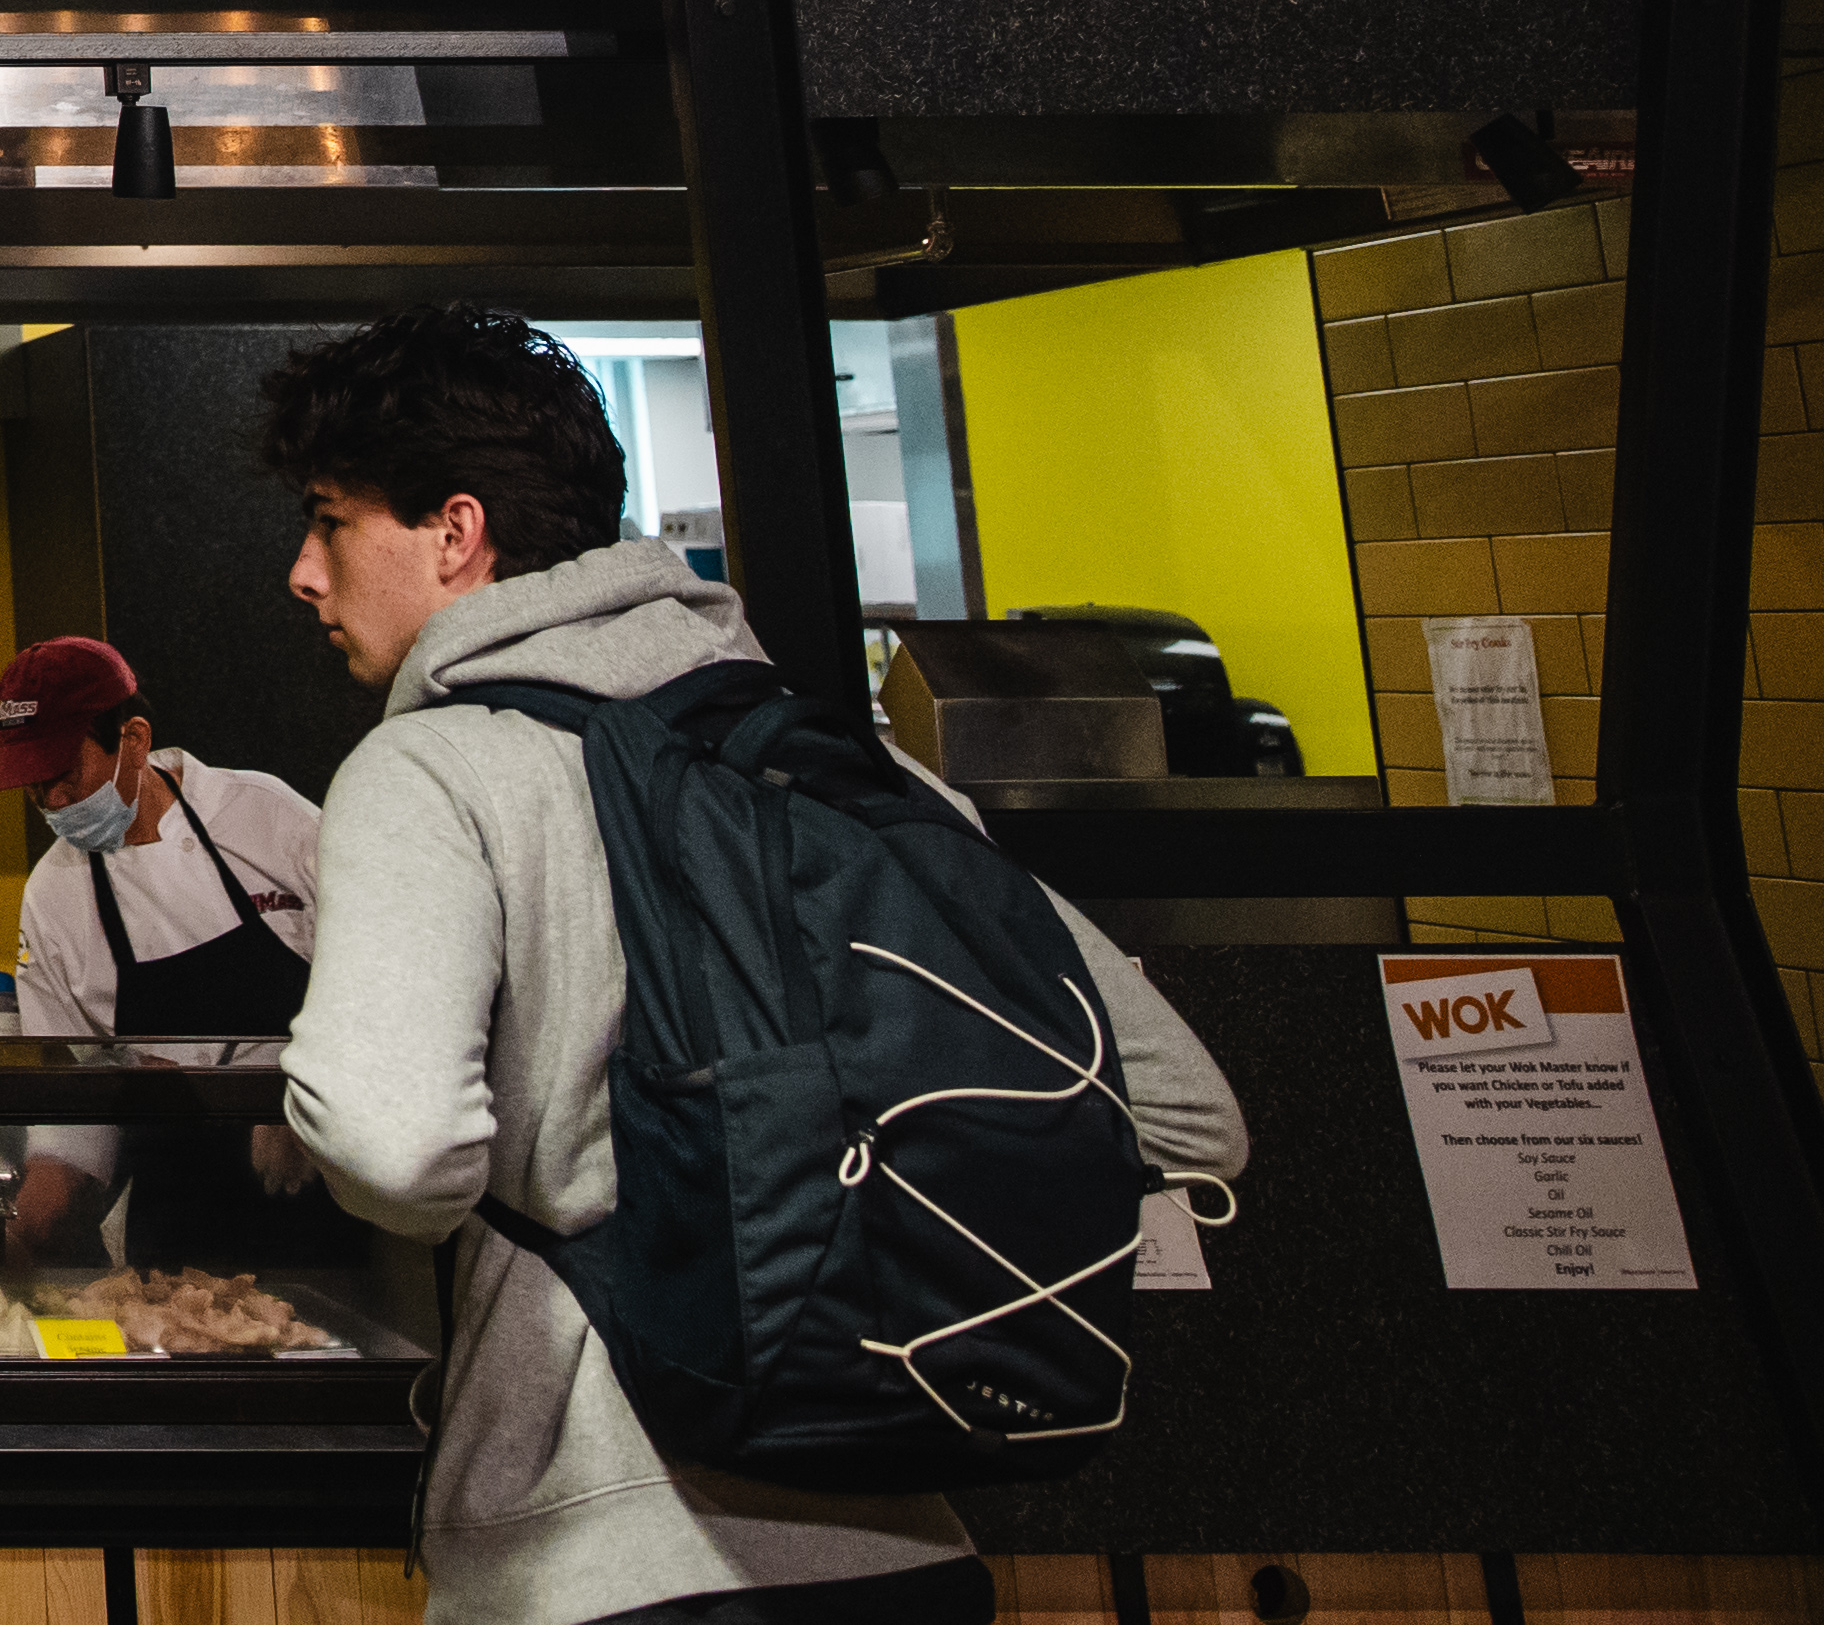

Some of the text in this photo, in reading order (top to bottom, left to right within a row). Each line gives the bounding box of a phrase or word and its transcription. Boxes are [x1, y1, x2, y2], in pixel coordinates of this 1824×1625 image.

[1402, 989, 1528, 1040] WOK
[1418, 1062, 1630, 1076] Please let your Wok Master know if
[1432, 1080, 1624, 1094] you want Chicken or Tofu added
[1464, 1098, 1602, 1112] with your Vegetables...
[1441, 1134, 1643, 1145] Then choose from our six sauces!
[1518, 1152, 1576, 1165] Soy Sauce
[1534, 1171, 1569, 1182] Garlic
[1548, 1189, 1564, 1200] Oil
[1528, 1208, 1593, 1219] Sesame Oil
[1504, 1226, 1626, 1240] Classic Stir Fry Sauce
[1546, 1245, 1592, 1256] Chili Oil
[1555, 1263, 1595, 1276] Enjoy!
